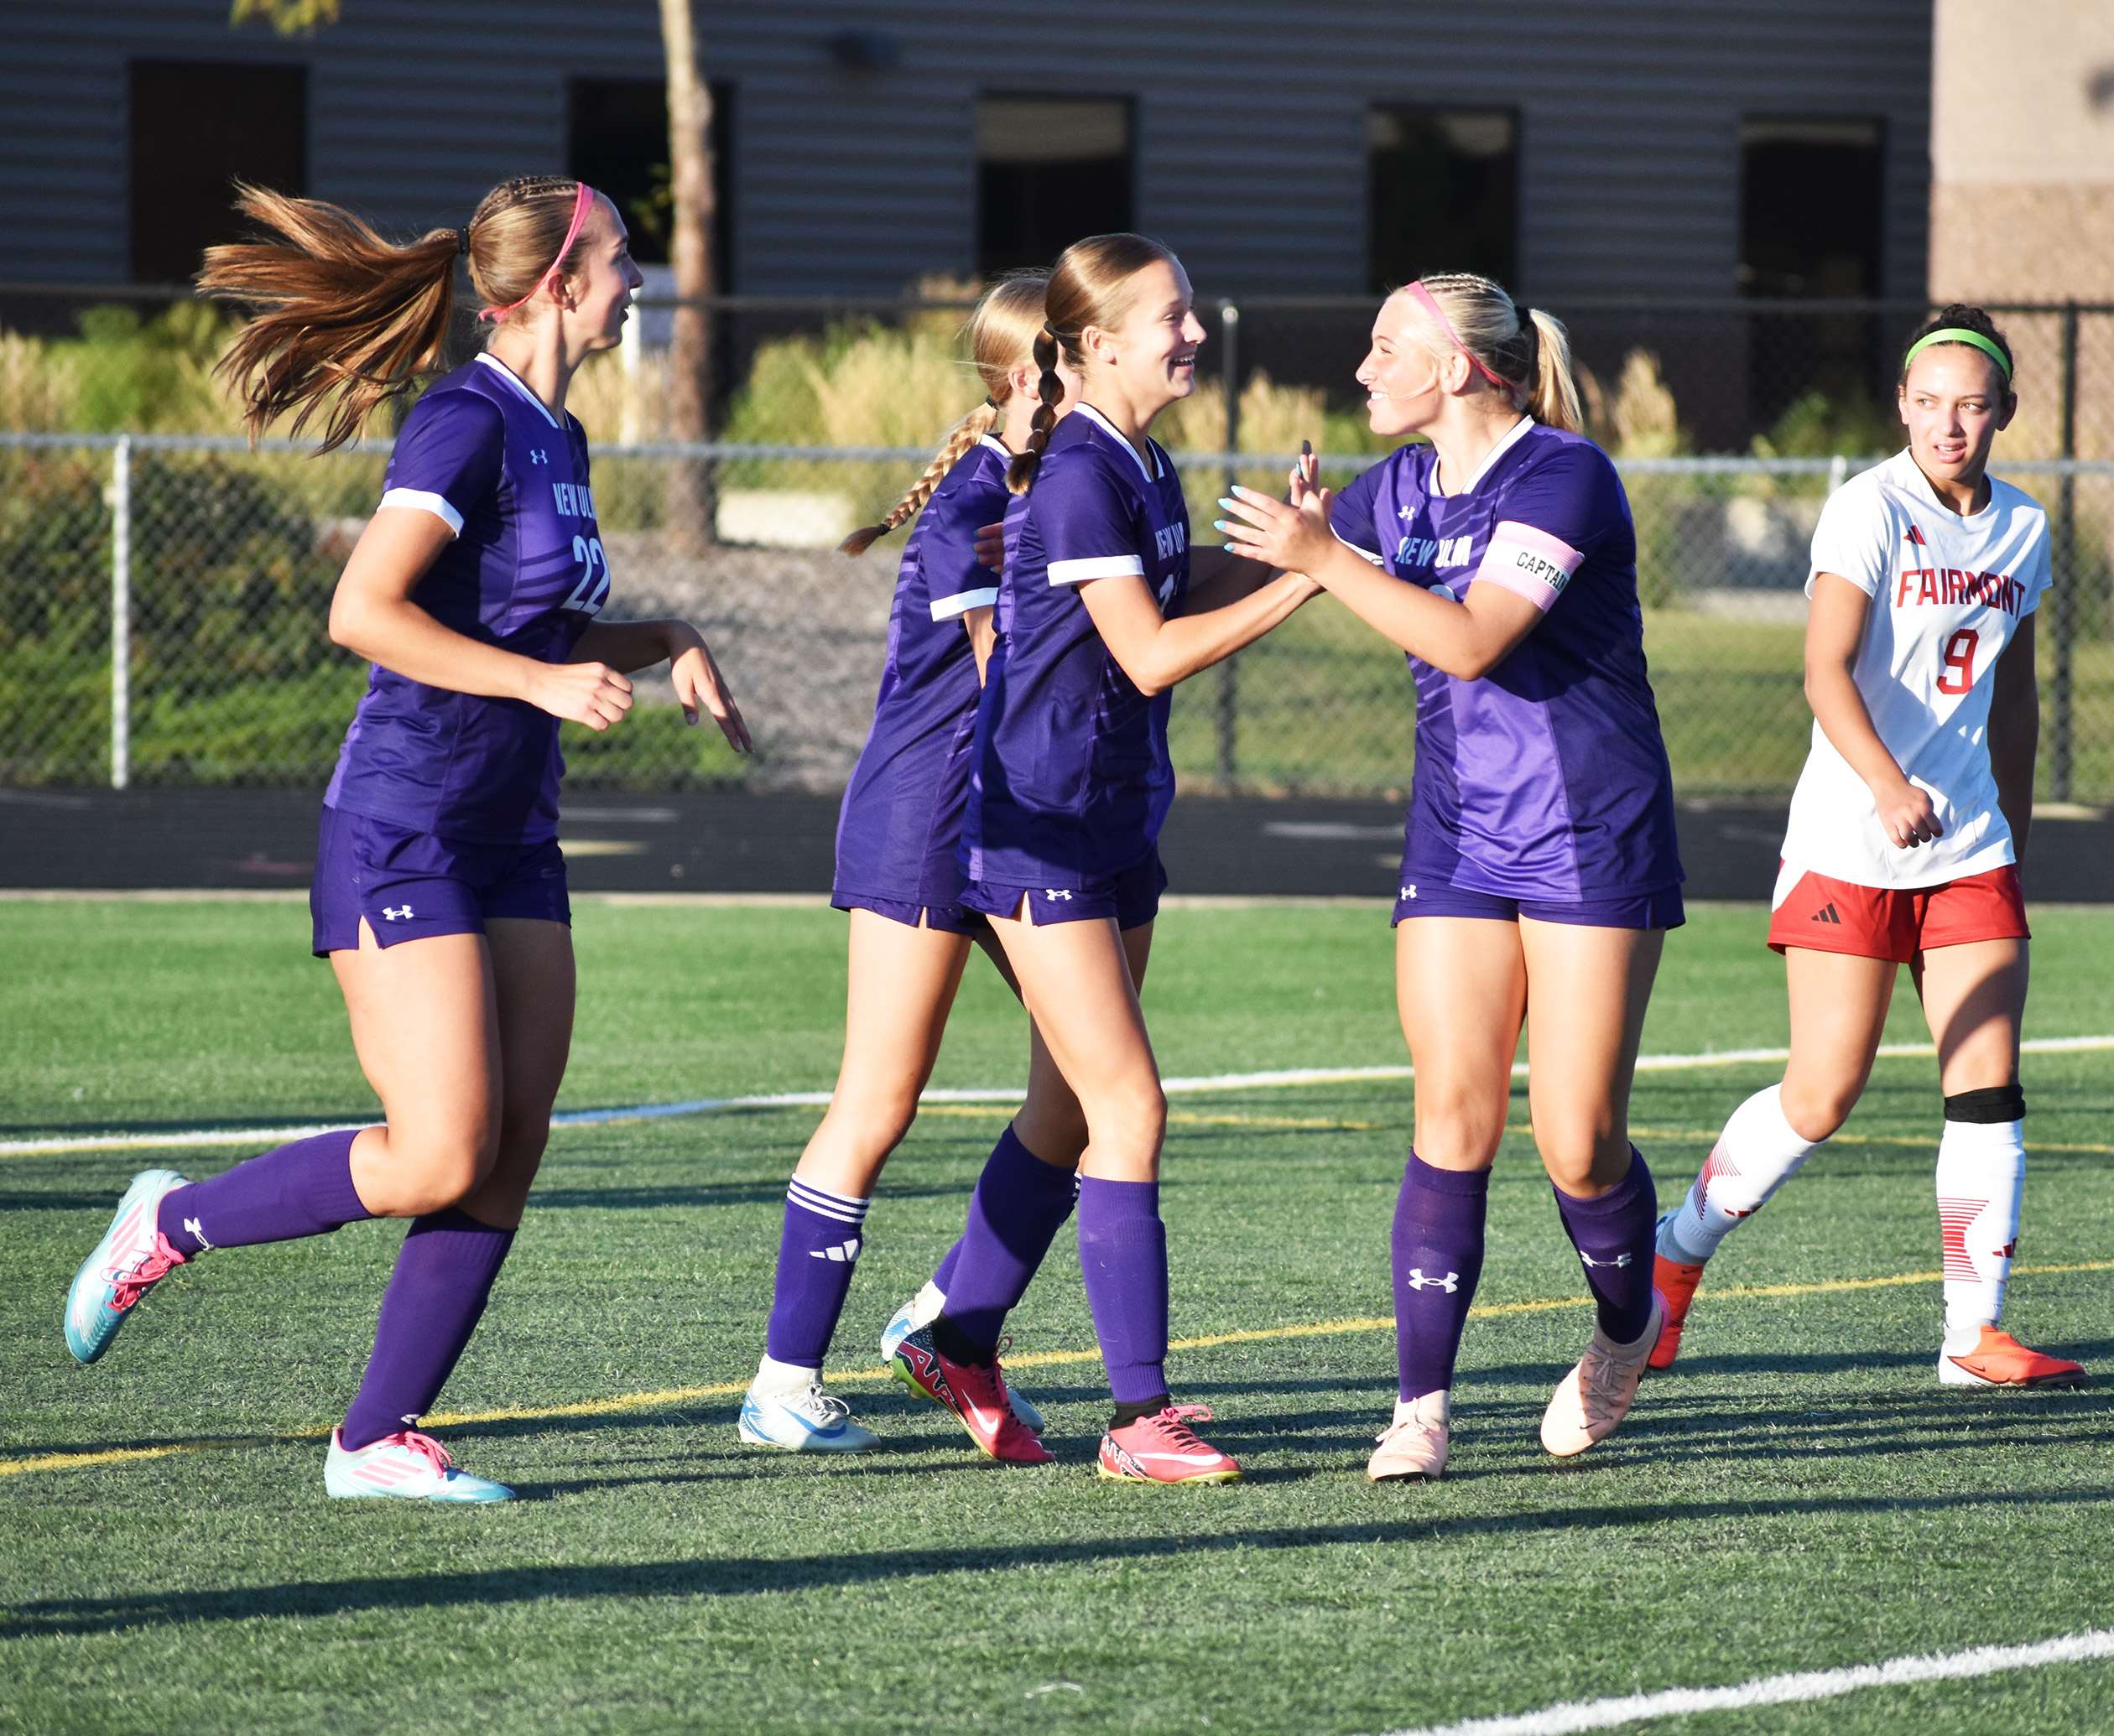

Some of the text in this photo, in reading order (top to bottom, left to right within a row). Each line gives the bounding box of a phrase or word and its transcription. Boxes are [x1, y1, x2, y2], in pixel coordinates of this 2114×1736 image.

[553, 483, 579, 517] NEW
[559, 534, 611, 615] 22
[1394, 535, 1473, 568] NEW ULM
[1897, 568, 2026, 621] FAIRMONT
[1937, 628, 1980, 695] 9
